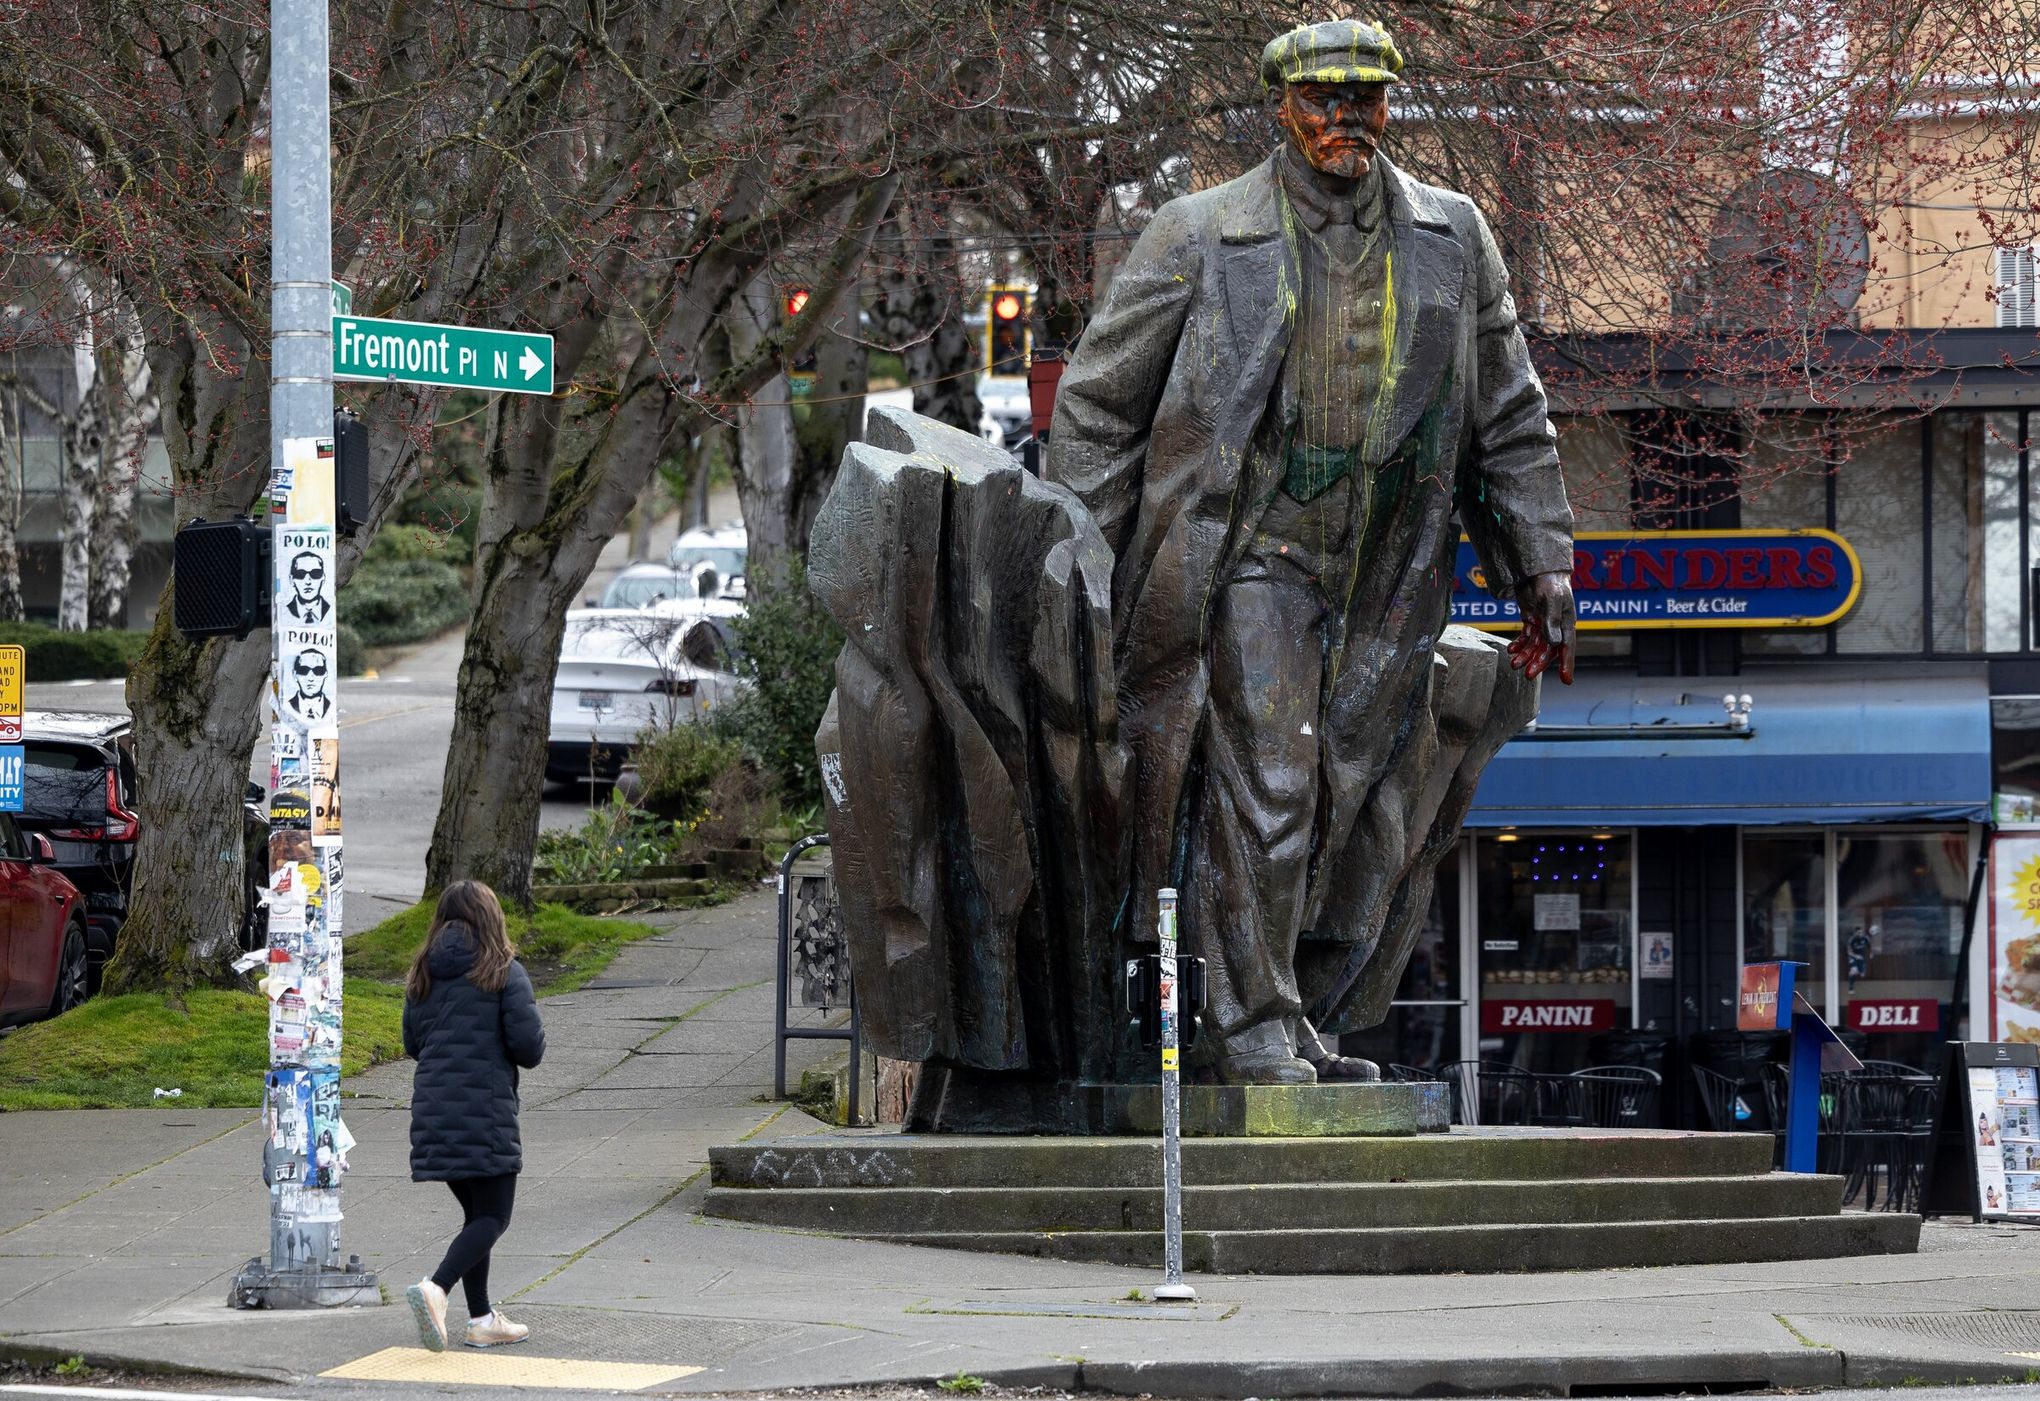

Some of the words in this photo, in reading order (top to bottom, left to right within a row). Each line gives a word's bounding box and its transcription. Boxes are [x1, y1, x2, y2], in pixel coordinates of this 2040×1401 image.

[340, 322, 450, 375] Fremont
[459, 347, 477, 377] Pl
[494, 351, 508, 380] N
[283, 535, 330, 549] POLO!
[1572, 546, 1837, 591] RINDERS
[1451, 602, 1498, 616] STED
[1579, 600, 1648, 614] PANINI
[1666, 598, 1695, 614] Beer
[1697, 598, 1709, 613] &
[1710, 597, 1748, 613] Cider
[288, 630, 333, 647] POLO!
[0, 652, 18, 660] UTE
[0, 787, 21, 798] ITY
[1501, 1006, 1594, 1026] PANINI
[1859, 1006, 1920, 1026] DELI
